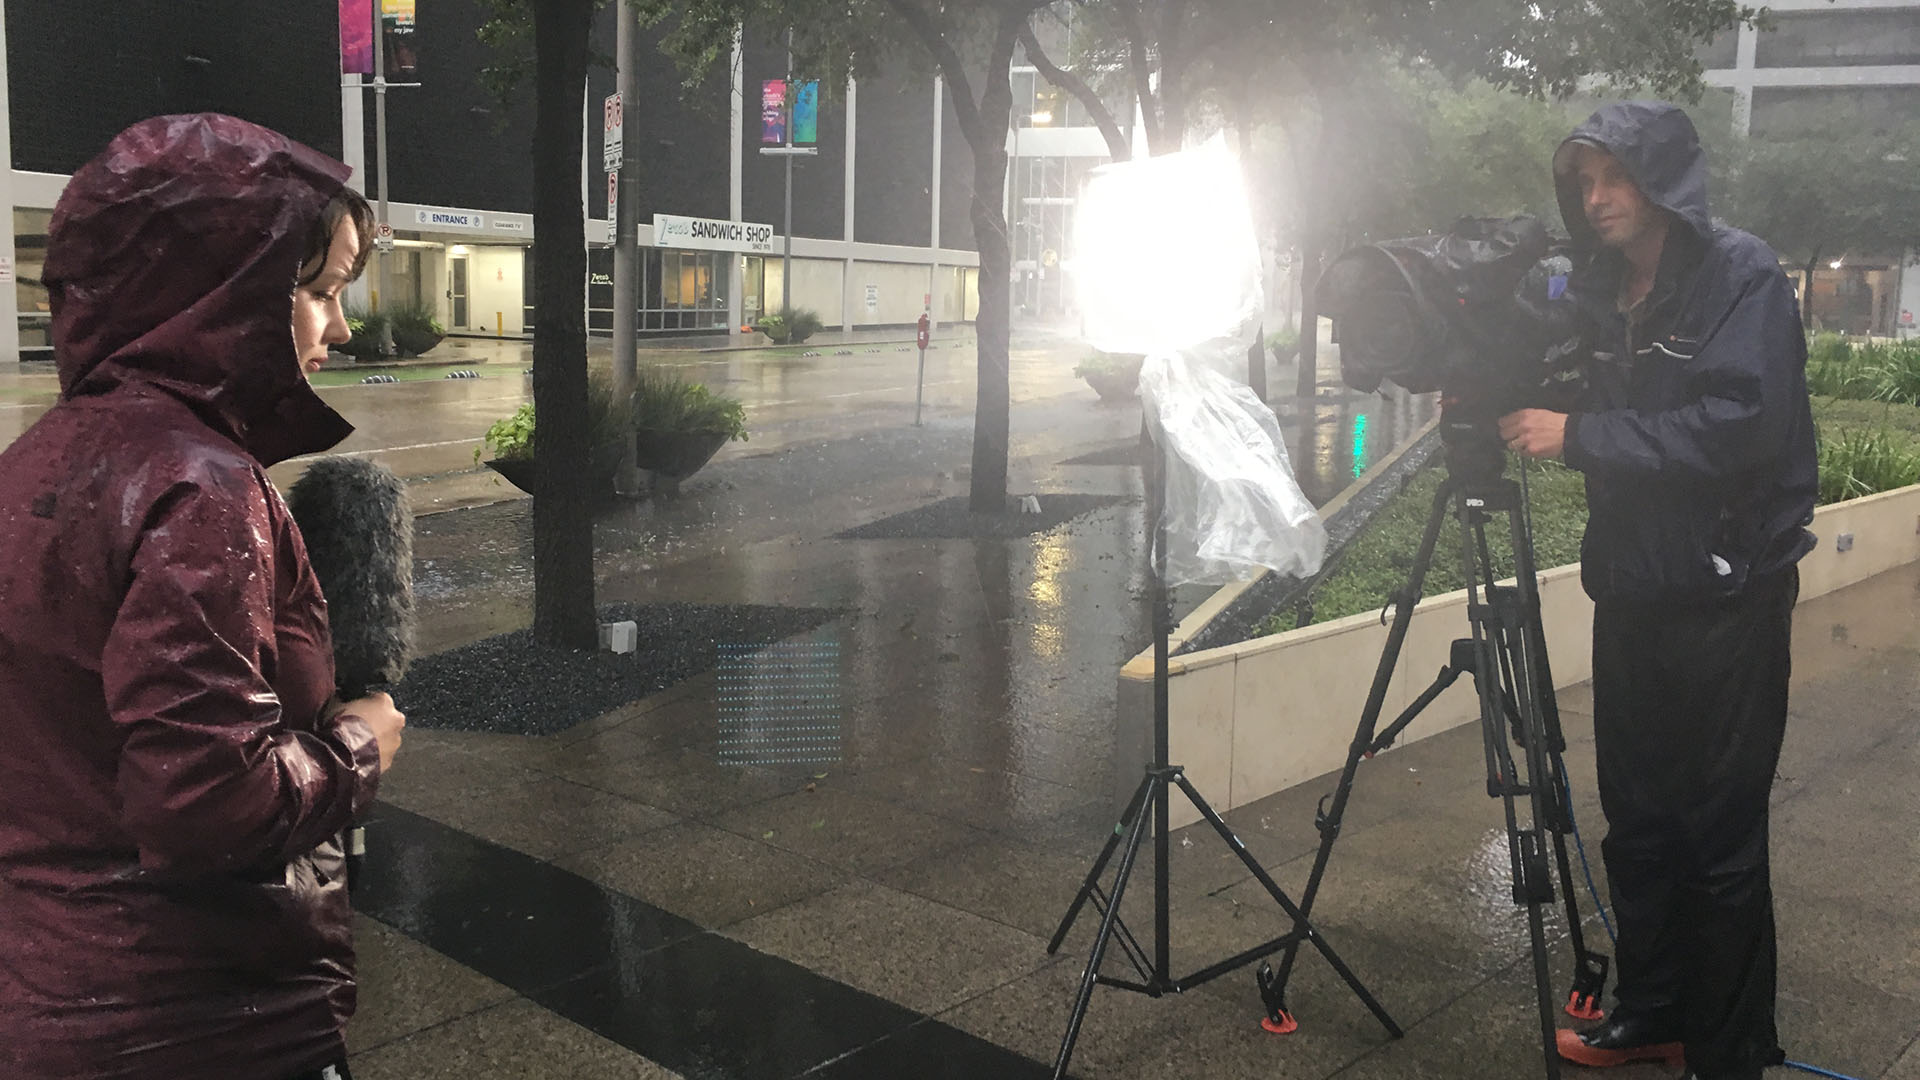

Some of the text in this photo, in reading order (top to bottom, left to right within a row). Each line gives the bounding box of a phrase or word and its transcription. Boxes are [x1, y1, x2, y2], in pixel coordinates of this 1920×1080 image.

[403, 26, 414, 34] jaw
[432, 213, 468, 225] ENTRANCE
[691, 221, 742, 241] SANDWICH
[746, 226, 771, 242] SHOP
